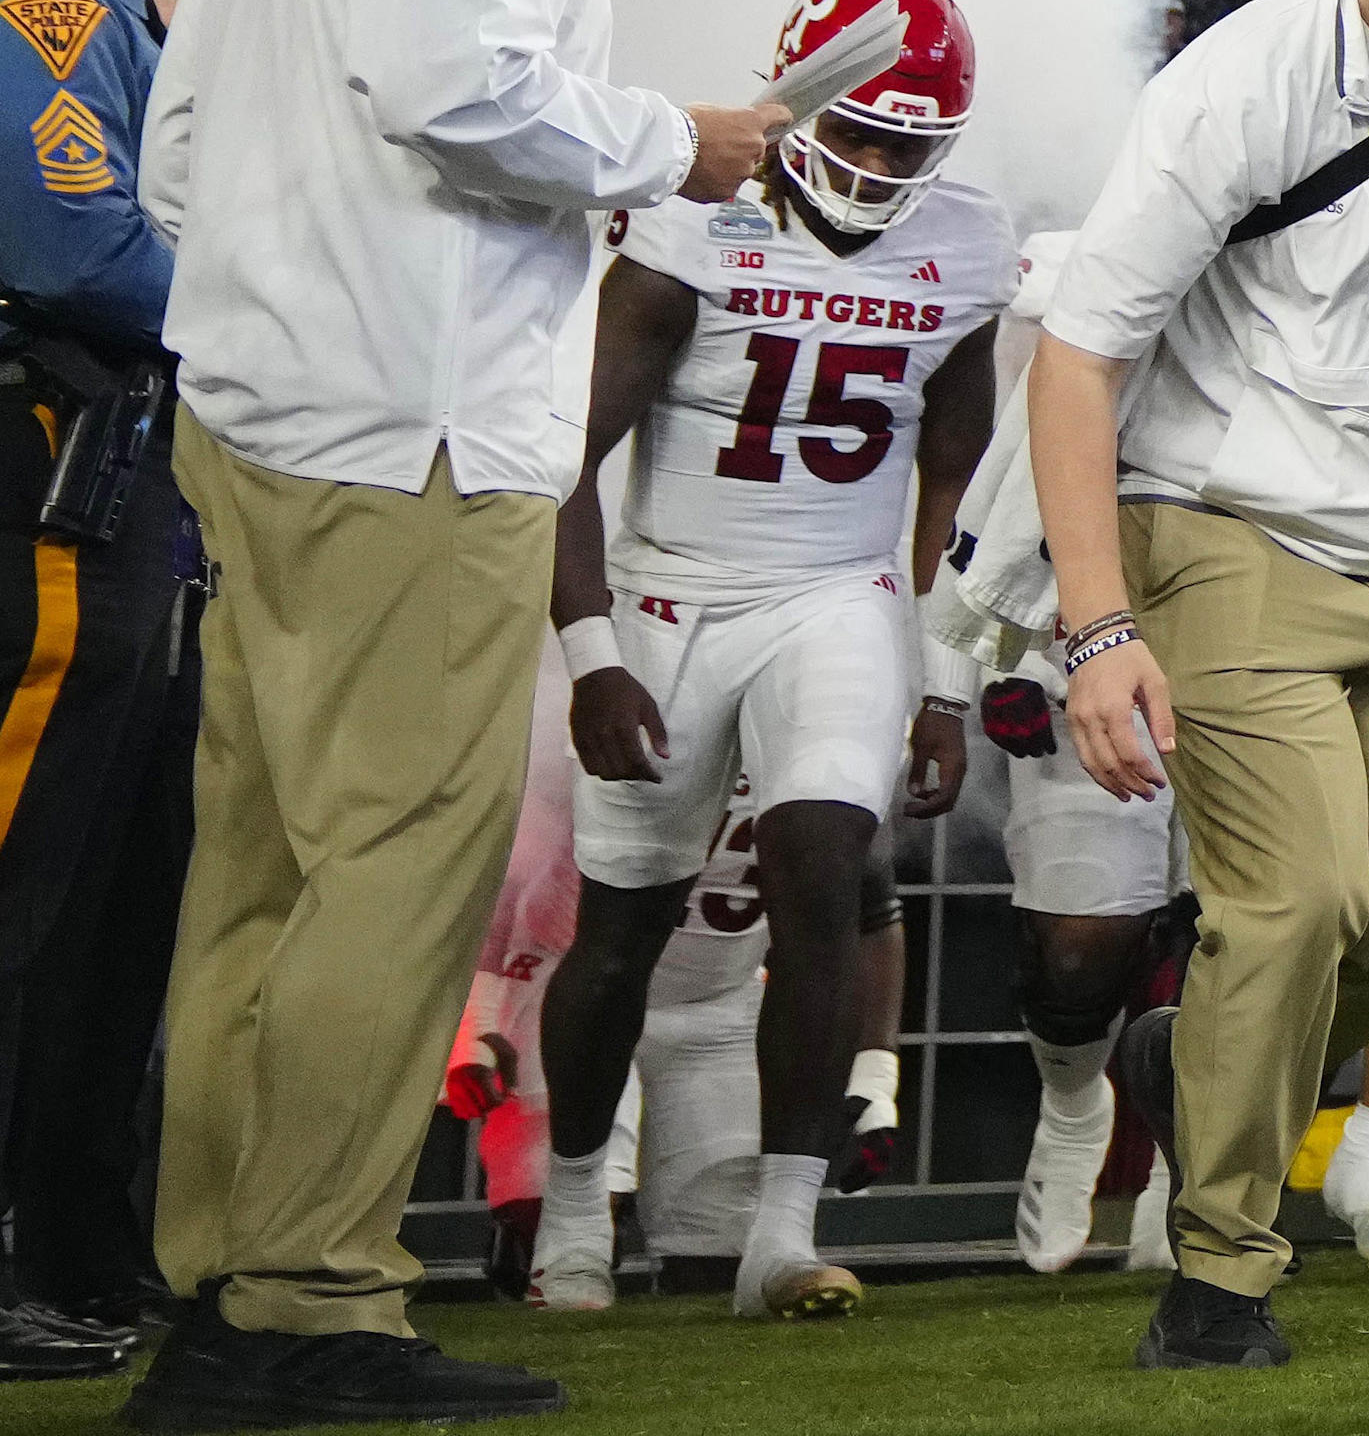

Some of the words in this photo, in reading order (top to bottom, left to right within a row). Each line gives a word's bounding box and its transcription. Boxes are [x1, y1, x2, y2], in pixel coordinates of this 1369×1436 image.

[20, 0, 90, 18] STATE
[30, 15, 85, 28] POLICE
[725, 287, 945, 333] RUTGERS
[716, 332, 911, 484] 15
